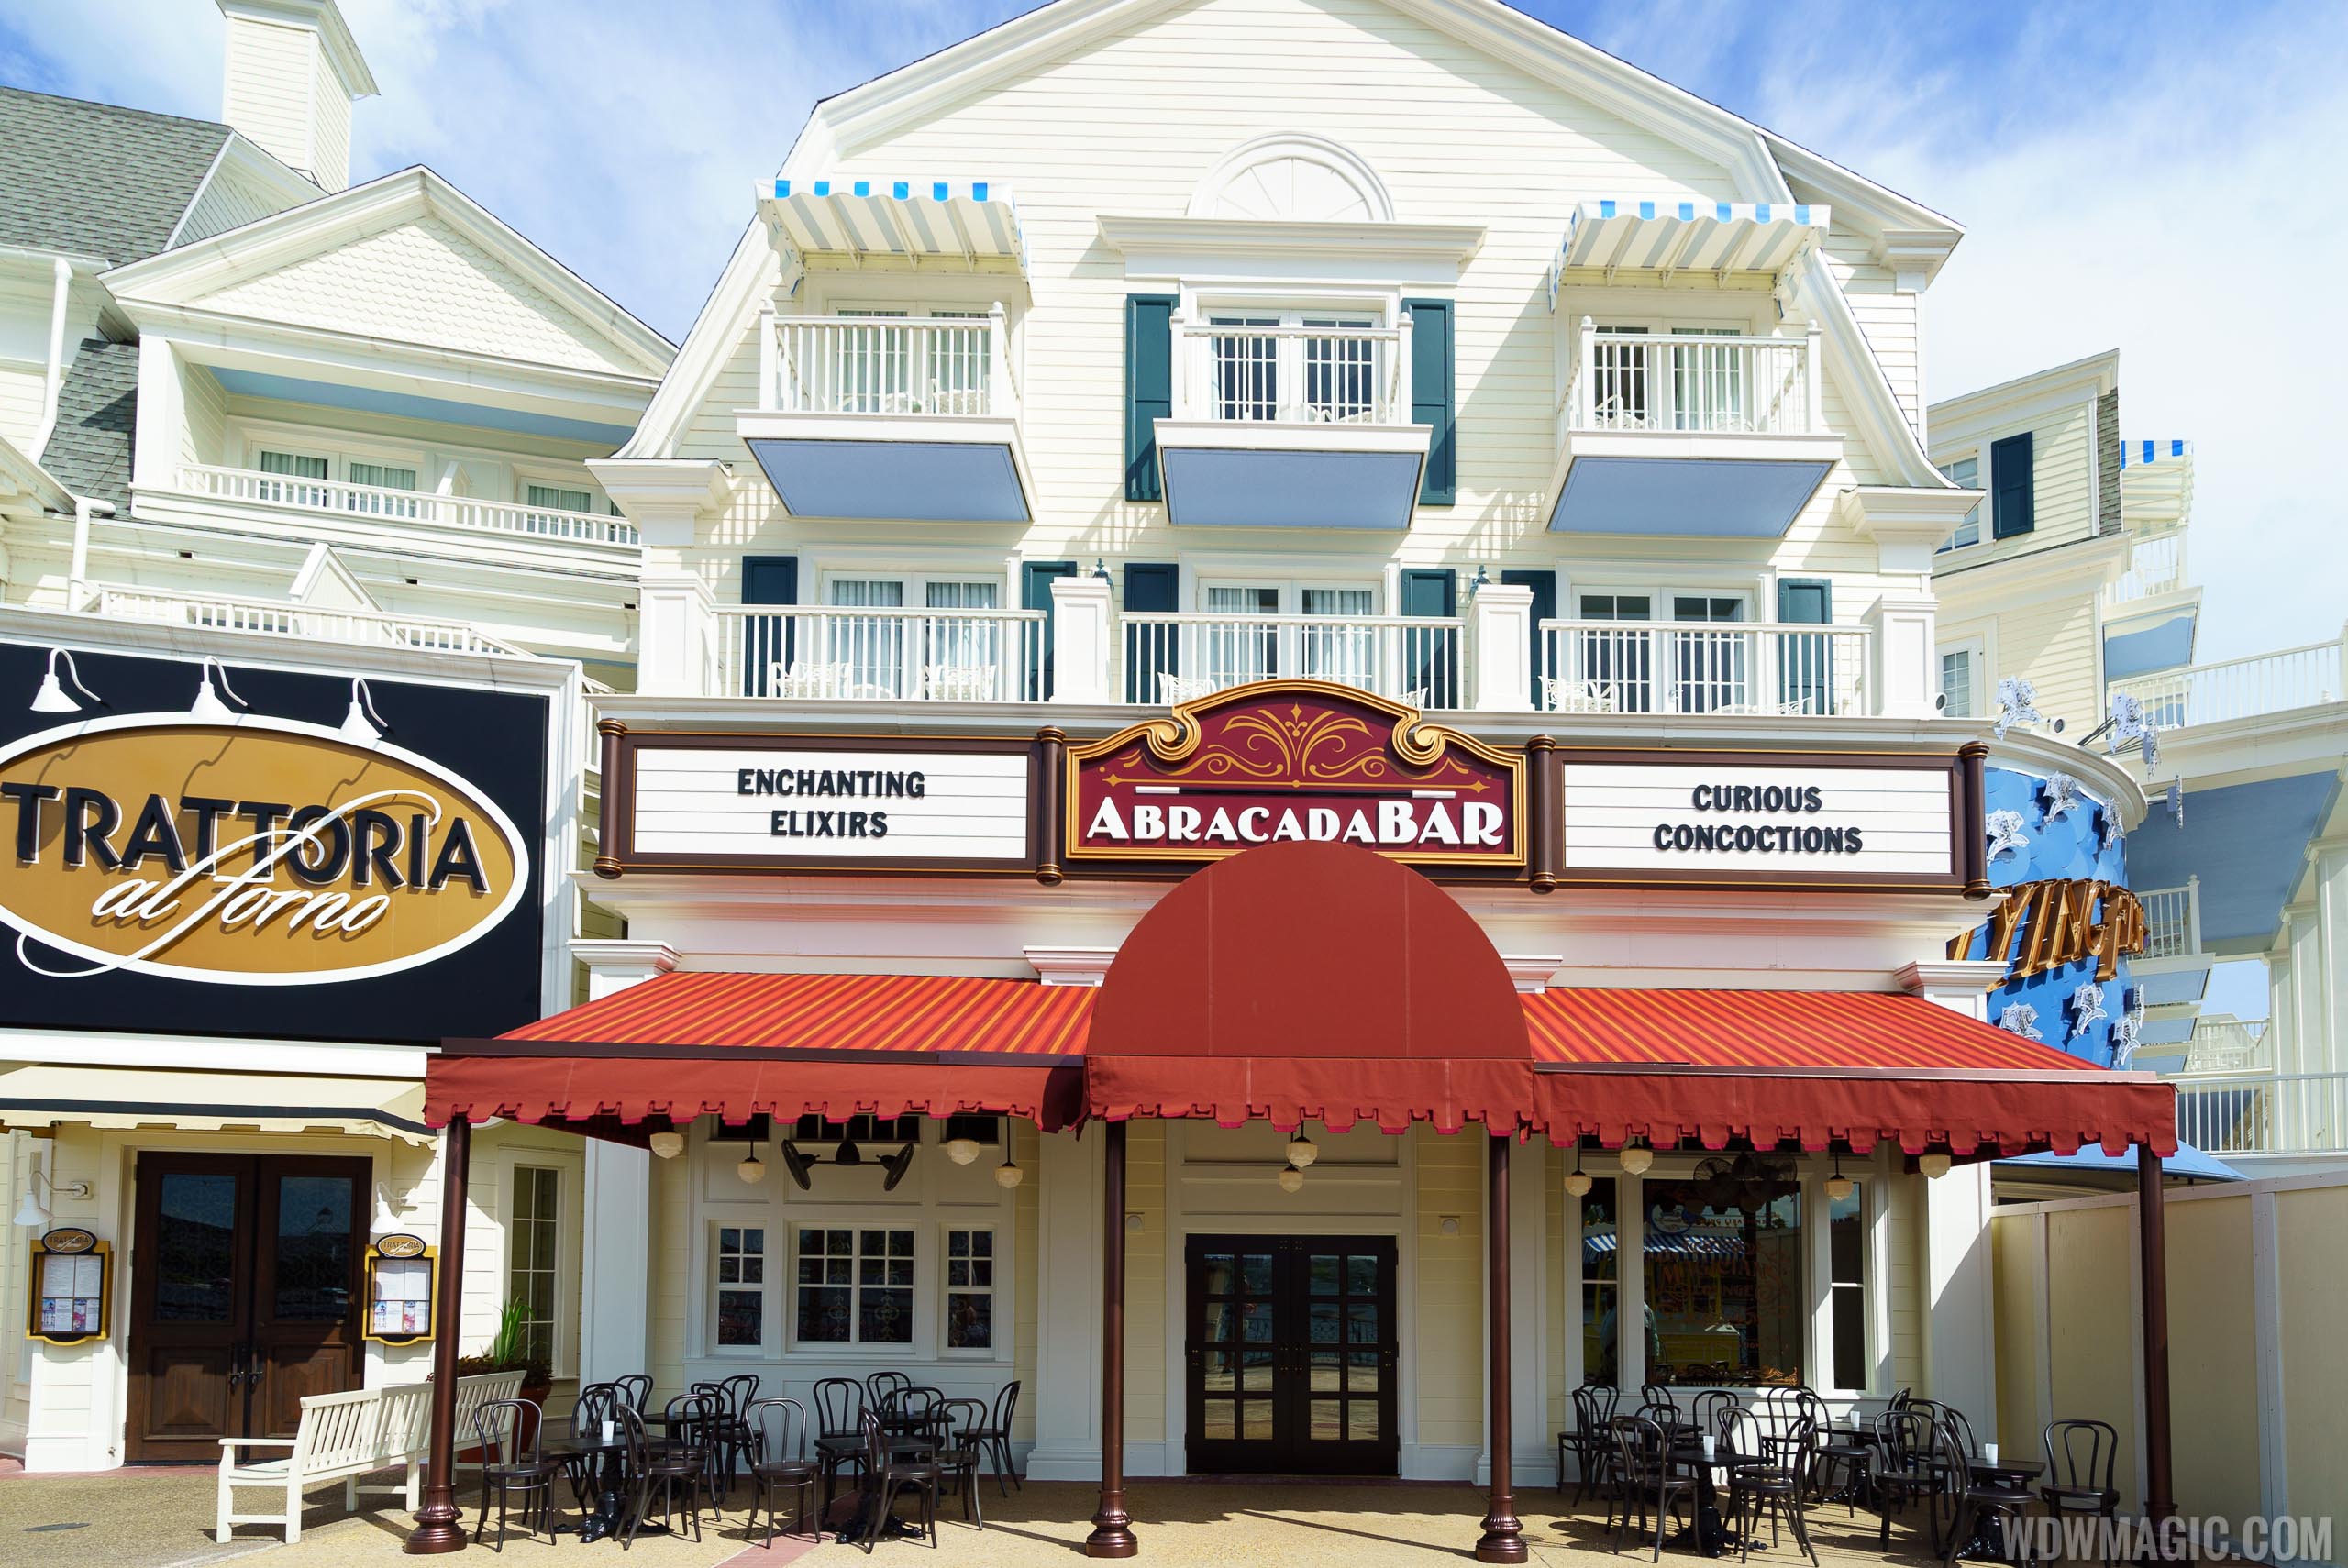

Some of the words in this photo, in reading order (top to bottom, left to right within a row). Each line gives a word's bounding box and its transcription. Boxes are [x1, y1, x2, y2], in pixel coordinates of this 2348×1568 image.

[737, 768, 925, 798] ENCHANTING
[1693, 785, 1822, 812] CURIOUS
[770, 810, 888, 837] ELIXIRS
[1087, 796, 1503, 845] ABRACADABAR
[1, 782, 492, 895] TRATTORIA
[1654, 823, 1863, 854] CONCOCTIONS
